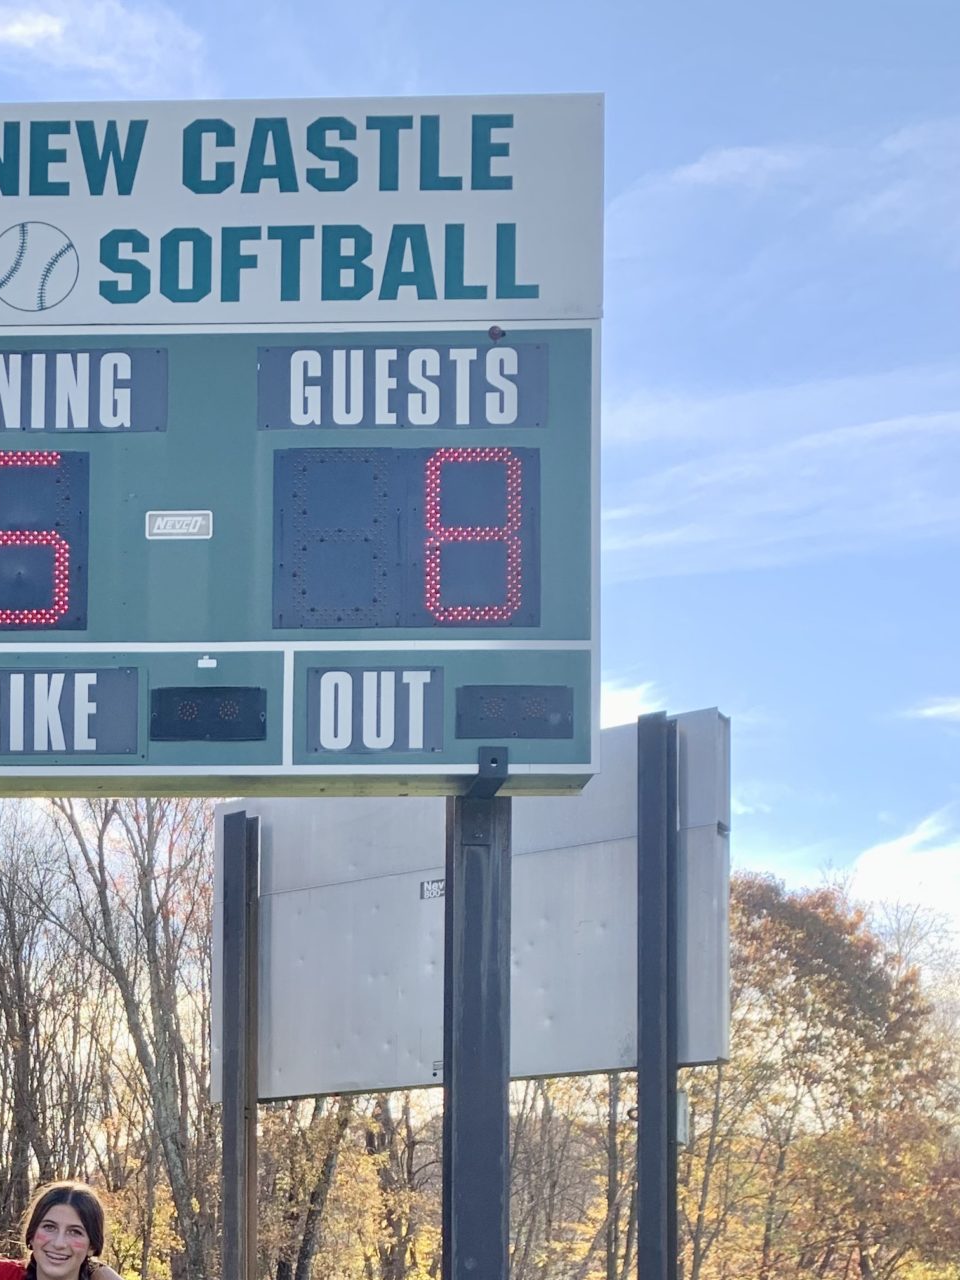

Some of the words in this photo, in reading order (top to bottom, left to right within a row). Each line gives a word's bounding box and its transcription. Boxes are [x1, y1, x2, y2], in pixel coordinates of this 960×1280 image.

[182, 114, 515, 194] CASTLE
[98, 222, 540, 304] SOFTBALL
[290, 347, 519, 426] GUESTS
[425, 448, 521, 621] 8
[320, 669, 431, 750] OUT
